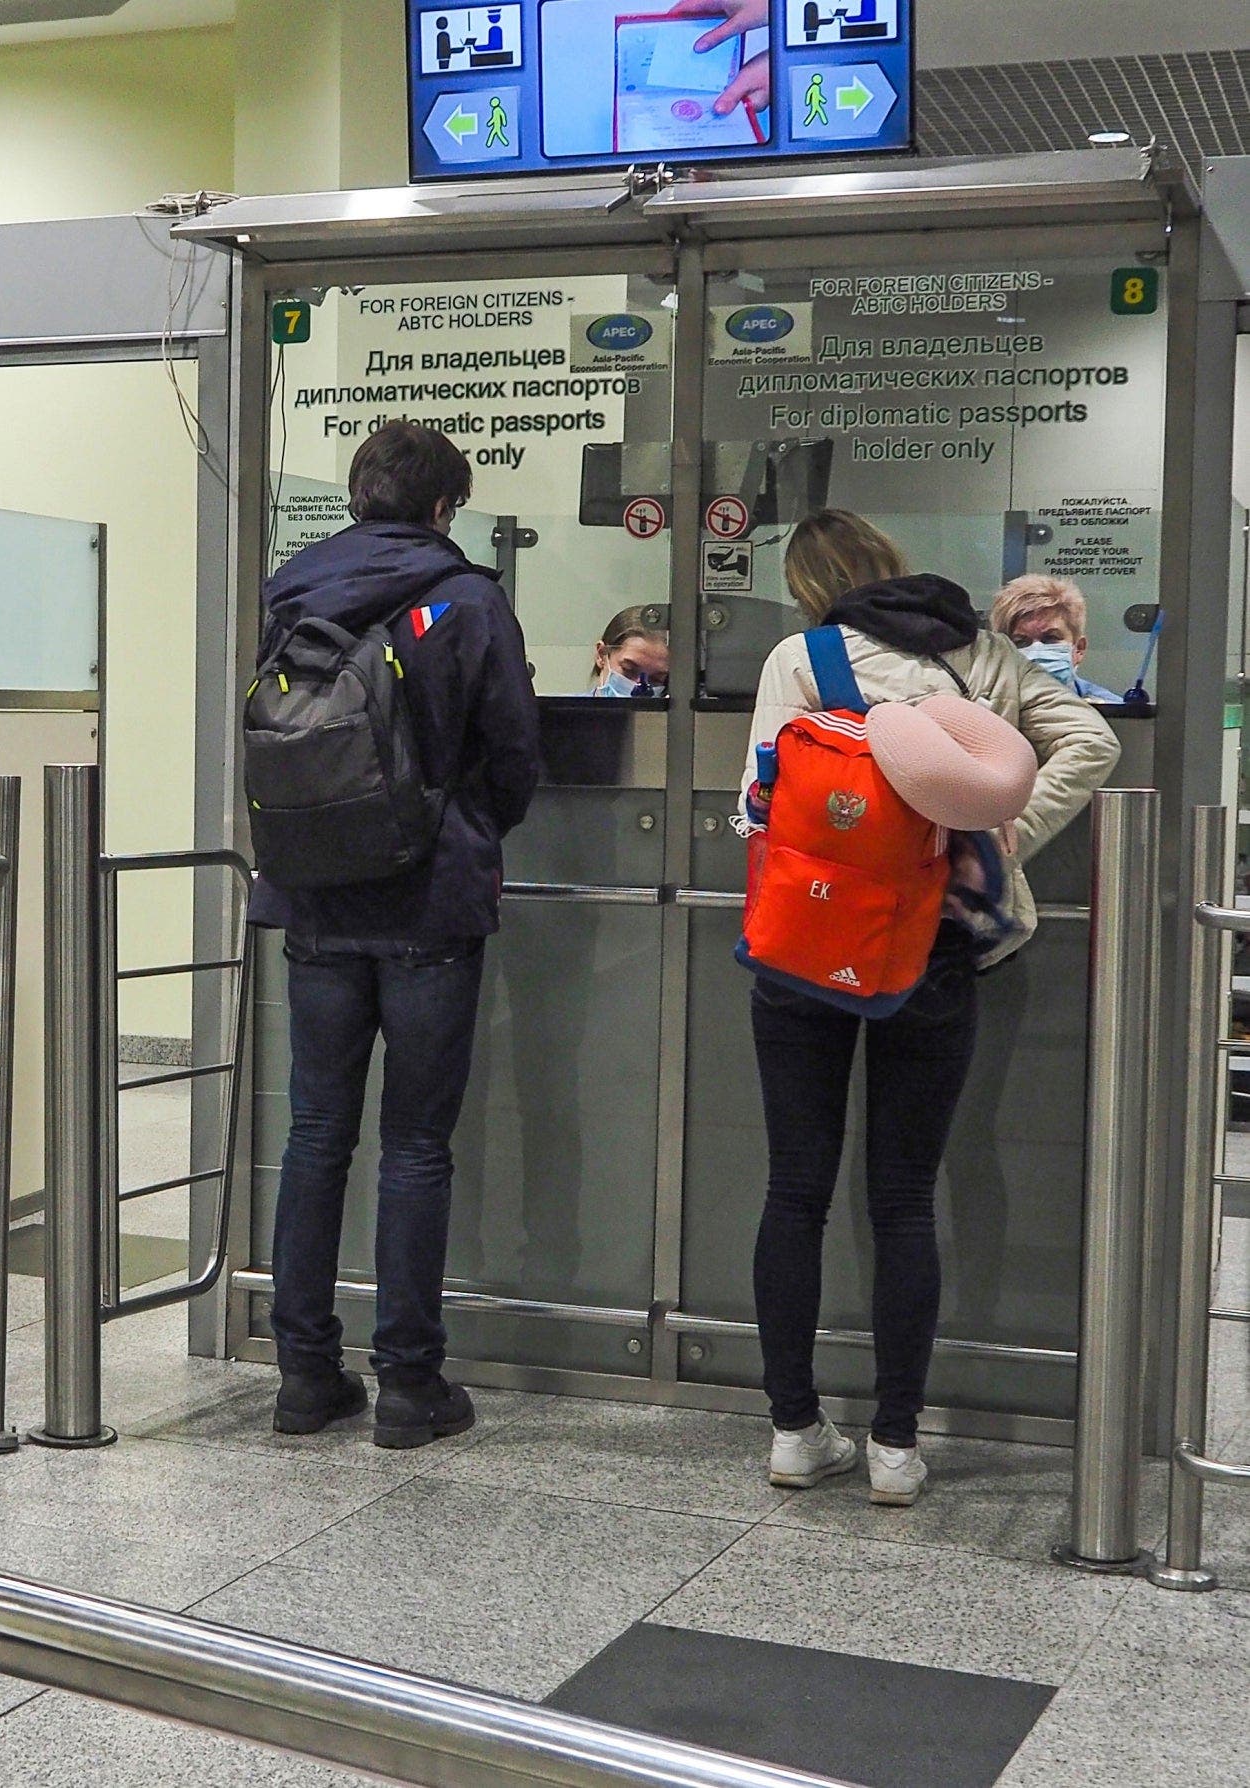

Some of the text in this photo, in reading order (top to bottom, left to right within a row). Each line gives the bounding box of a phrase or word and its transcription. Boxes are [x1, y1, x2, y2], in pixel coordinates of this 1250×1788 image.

[810, 278, 852, 297] FOR
[855, 275, 948, 296] FOREIGN
[950, 273, 1042, 292] CITIZENS
[1124, 277, 1145, 304] 8
[360, 299, 396, 314] FOR
[400, 295, 478, 313] FOREIGN
[483, 291, 563, 309] CITIZENS
[852, 293, 1006, 315] ABTC HOLDERS
[284, 310, 301, 334] 7
[397, 311, 533, 332] ABTC HOLDERS
[742, 319, 777, 330] APEC
[602, 327, 636, 338] APEC
[732, 346, 787, 356] Asia-Pacific
[818, 333, 1045, 363] Для владельцев
[366, 347, 565, 376] Для владельцев
[592, 353, 645, 363] Asia-Pacific
[709, 355, 811, 366] Economic Cooperation
[570, 362, 668, 373] Economic Cooperation
[738, 365, 1129, 397] дипломатических паспортов
[295, 376, 641, 408] дипломатических паспортов
[770, 399, 1088, 432] For diplomatic passports
[324, 415, 361, 438] For
[491, 410, 605, 439] passports
[852, 435, 995, 465] holder only
[476, 442, 526, 470] only
[289, 494, 344, 503] ПОЖАЛУЙСТА
[1061, 497, 1128, 507] ПОЖАЛУЙСТА
[325, 504, 348, 512] ПАСП
[1039, 507, 1151, 517] ПРЕДЪЯВИТЕ ПАСПОРТ
[305, 513, 345, 521] ОБЛОЖКИ
[1060, 517, 1129, 526] БЕЗ ОБЛОЖКИ
[1075, 537, 1112, 546] PLEASE
[1058, 547, 1129, 555] PROVIDE YOUR
[1044, 557, 1143, 566] PASSPORT WITHOUT
[1050, 567, 1136, 576] PASSPORT COVER
[829, 974, 861, 987] adidas
